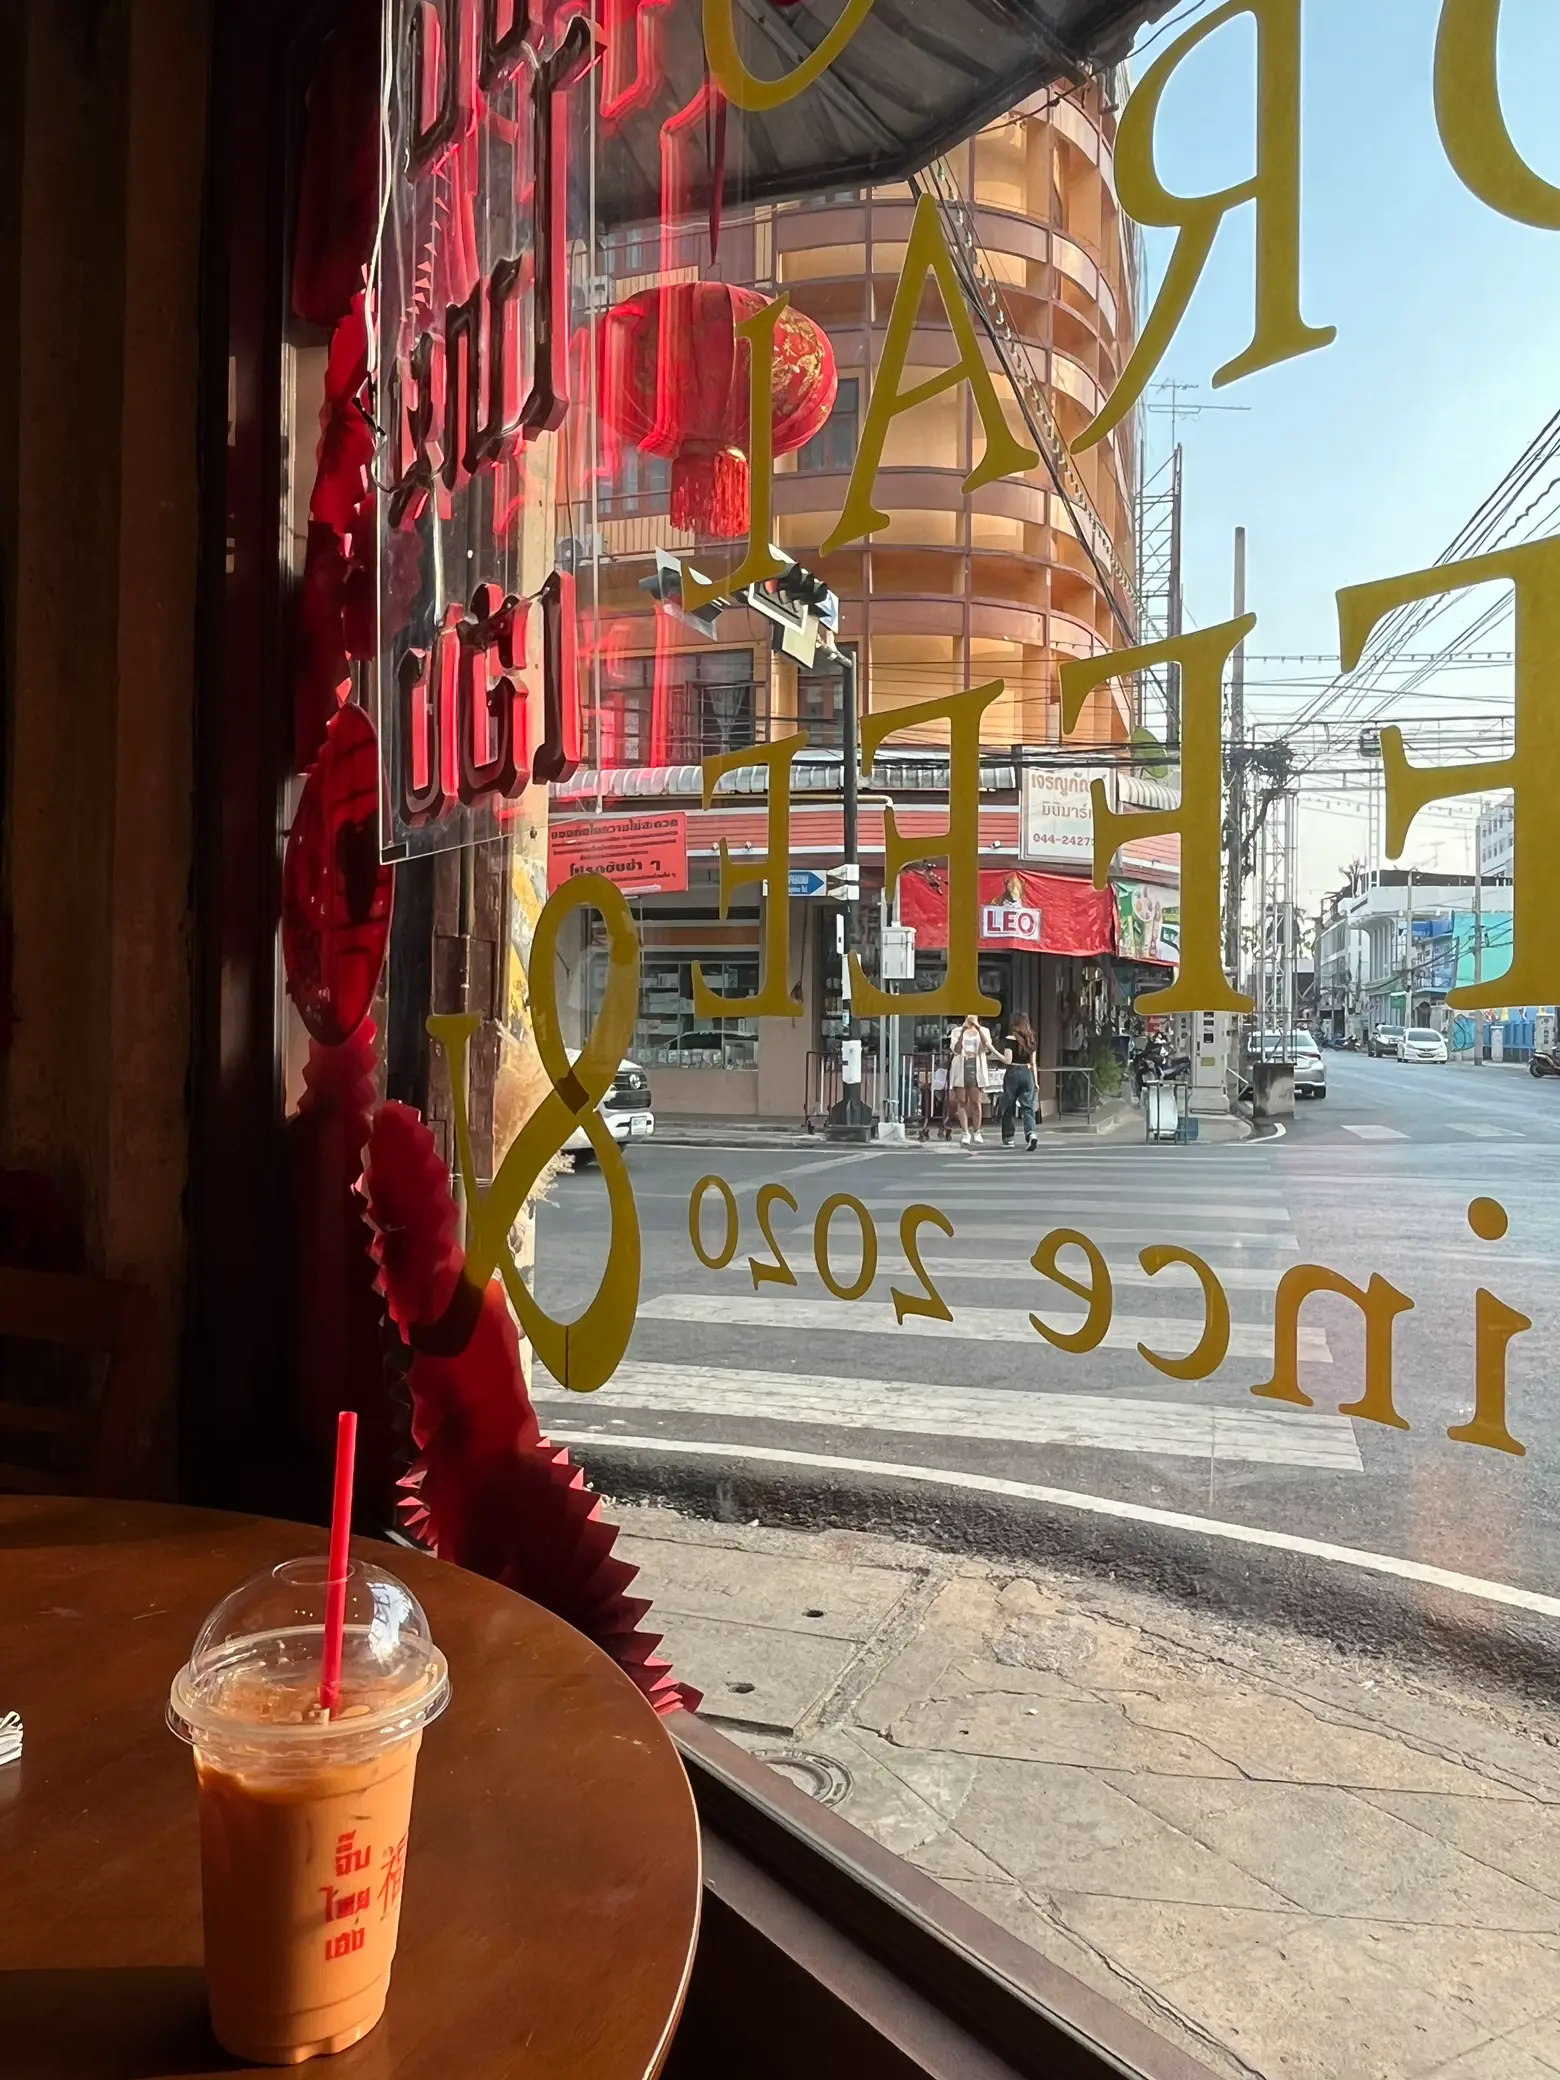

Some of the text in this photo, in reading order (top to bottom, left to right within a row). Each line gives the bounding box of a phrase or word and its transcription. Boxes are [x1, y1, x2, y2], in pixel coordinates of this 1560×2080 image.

[1041, 800, 1092, 819] มินิมาร์
[1033, 832, 1094, 847] 044-2427
[987, 910, 1035, 934] LEO
